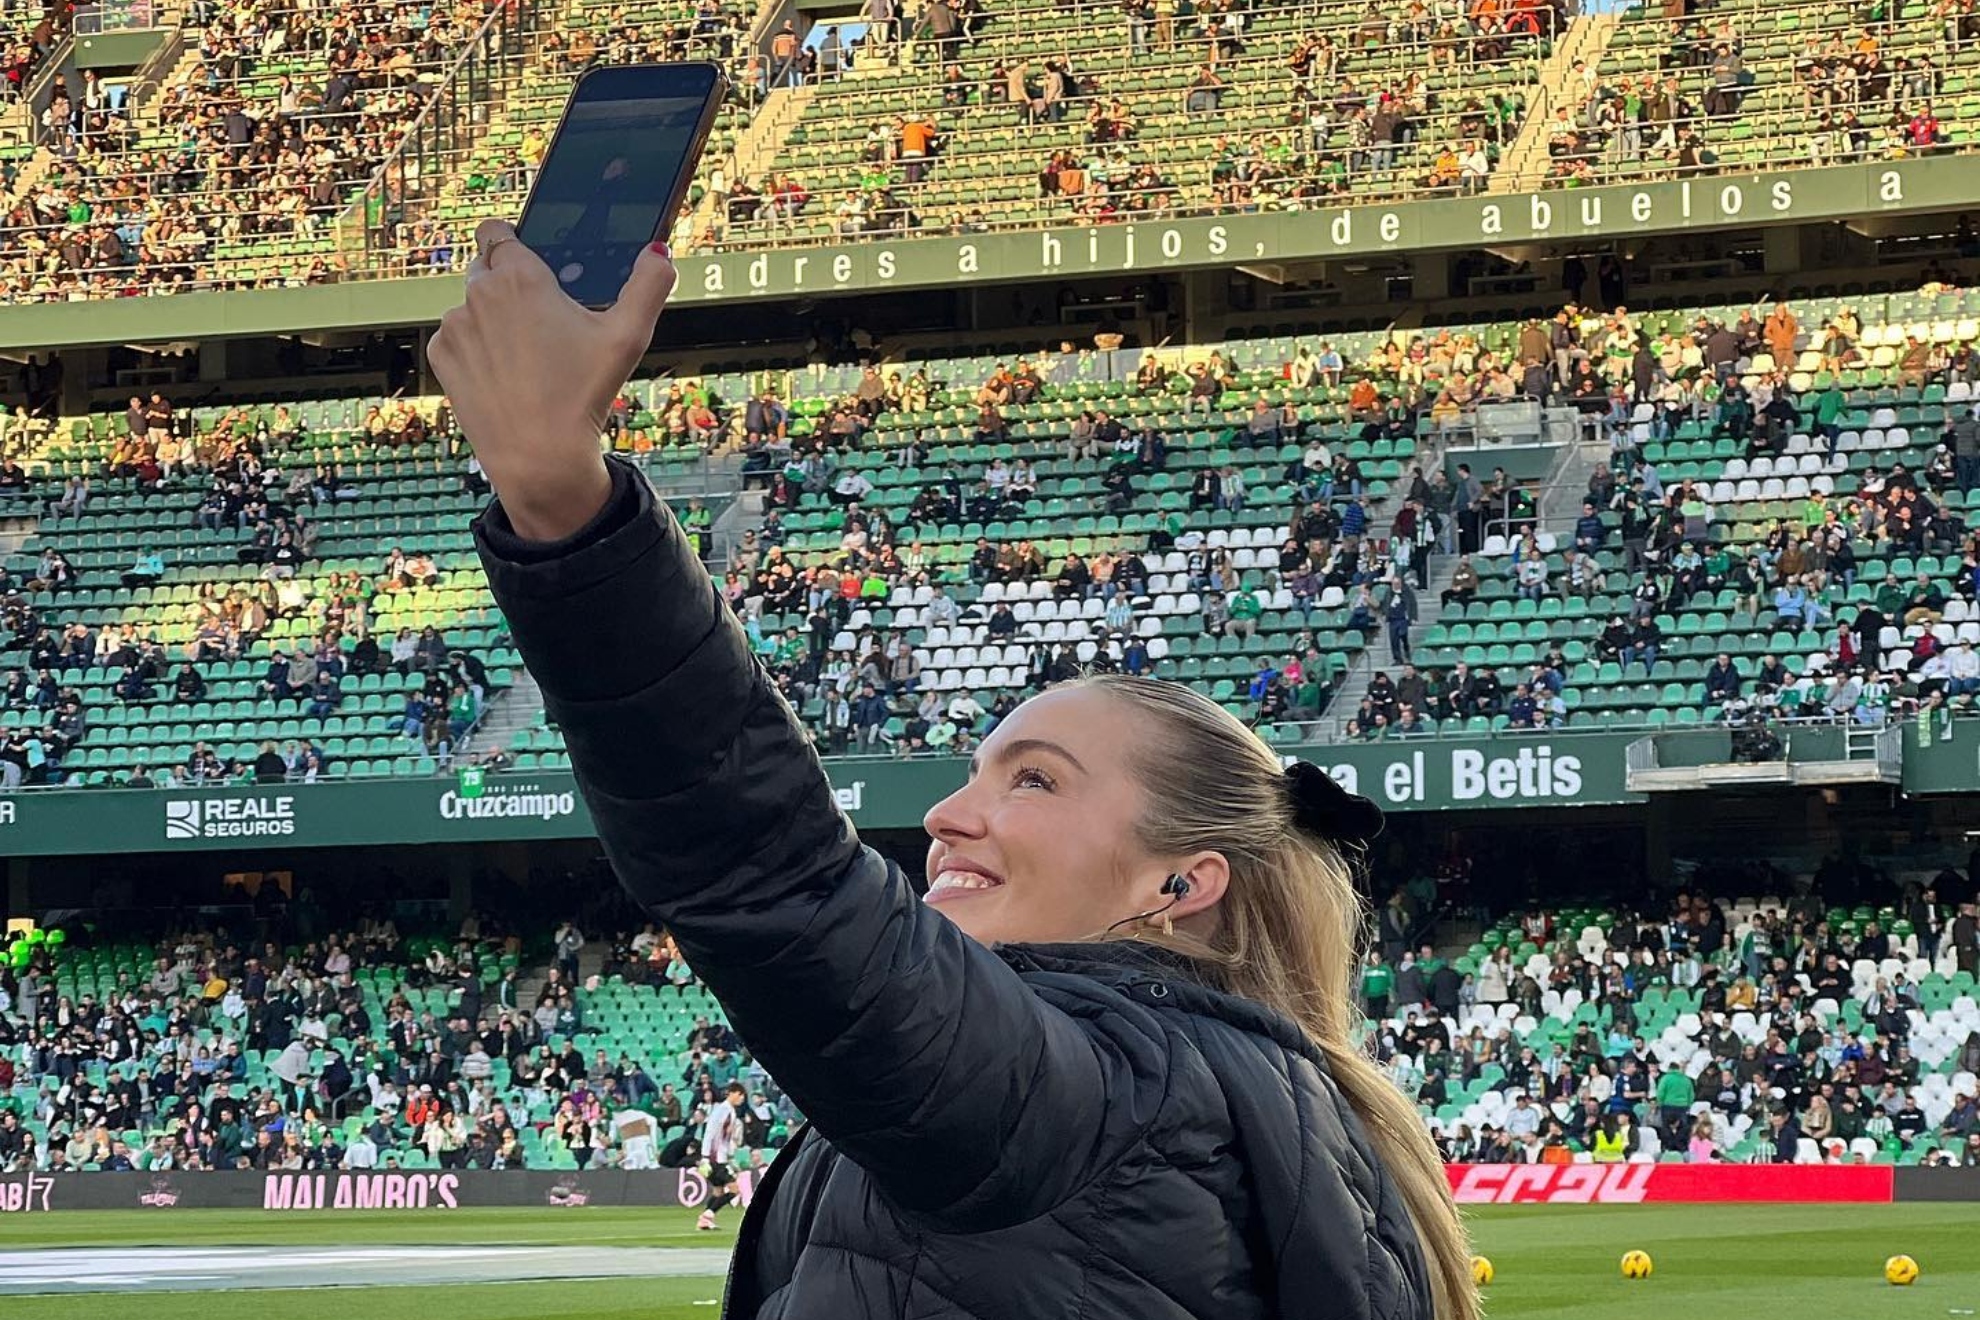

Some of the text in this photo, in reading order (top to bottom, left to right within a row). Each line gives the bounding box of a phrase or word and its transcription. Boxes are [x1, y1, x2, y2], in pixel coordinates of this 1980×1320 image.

[673, 250, 896, 295] adres
[958, 244, 979, 272] a
[1042, 226, 1265, 268] hijos,
[1331, 209, 1400, 245] de
[1880, 170, 1903, 201] a
[1385, 751, 1424, 802] el
[1452, 746, 1582, 799] Betis
[205, 797, 294, 820] REALE
[440, 789, 575, 820] Cruzcampo
[204, 820, 295, 837] SEGUROS
